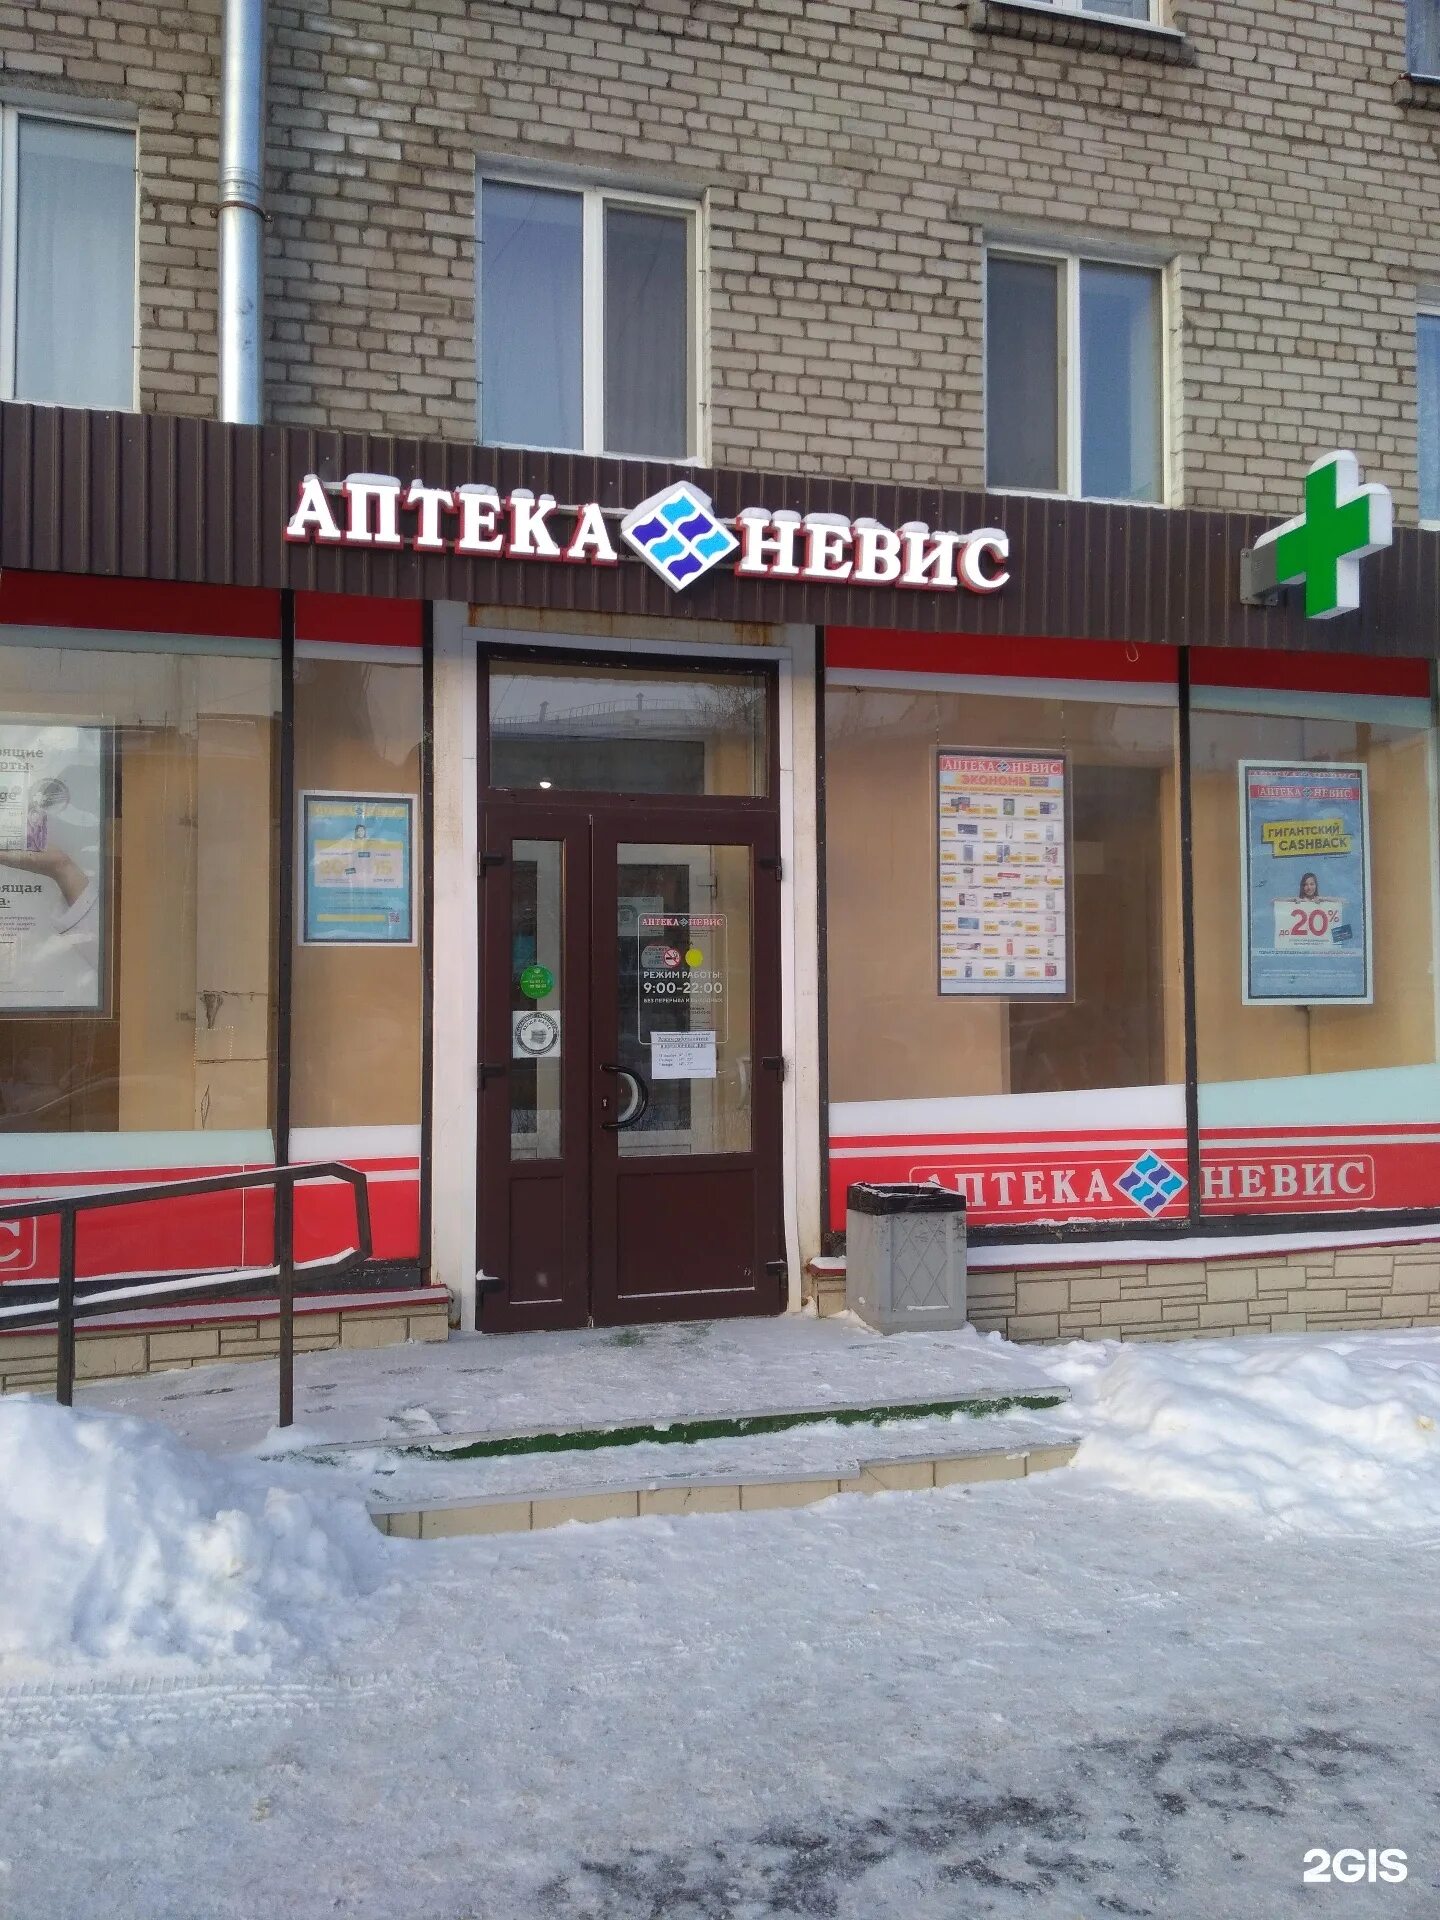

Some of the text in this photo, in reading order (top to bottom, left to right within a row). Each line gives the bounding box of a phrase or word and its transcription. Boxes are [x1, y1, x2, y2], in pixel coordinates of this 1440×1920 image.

[286, 475, 1010, 594] АПТЕКА НЕВИС
[945, 760, 1061, 774] АПТЕКА НЕВИС
[1260, 787, 1351, 798] АПТЕКА НЕВИС
[1268, 822, 1341, 838] ГИГАНТСКИЙ
[1279, 838, 1348, 850] CASHBACK
[0, 884, 42, 894] ящая
[642, 918, 723, 926] АПТЕКА НЕВИС
[1291, 908, 1339, 936] 20%
[643, 971, 680, 979] РЕЖИМ
[643, 982, 723, 994] 9:00-22:00
[929, 1162, 1367, 1207] ПТЕКА НЕВИС
